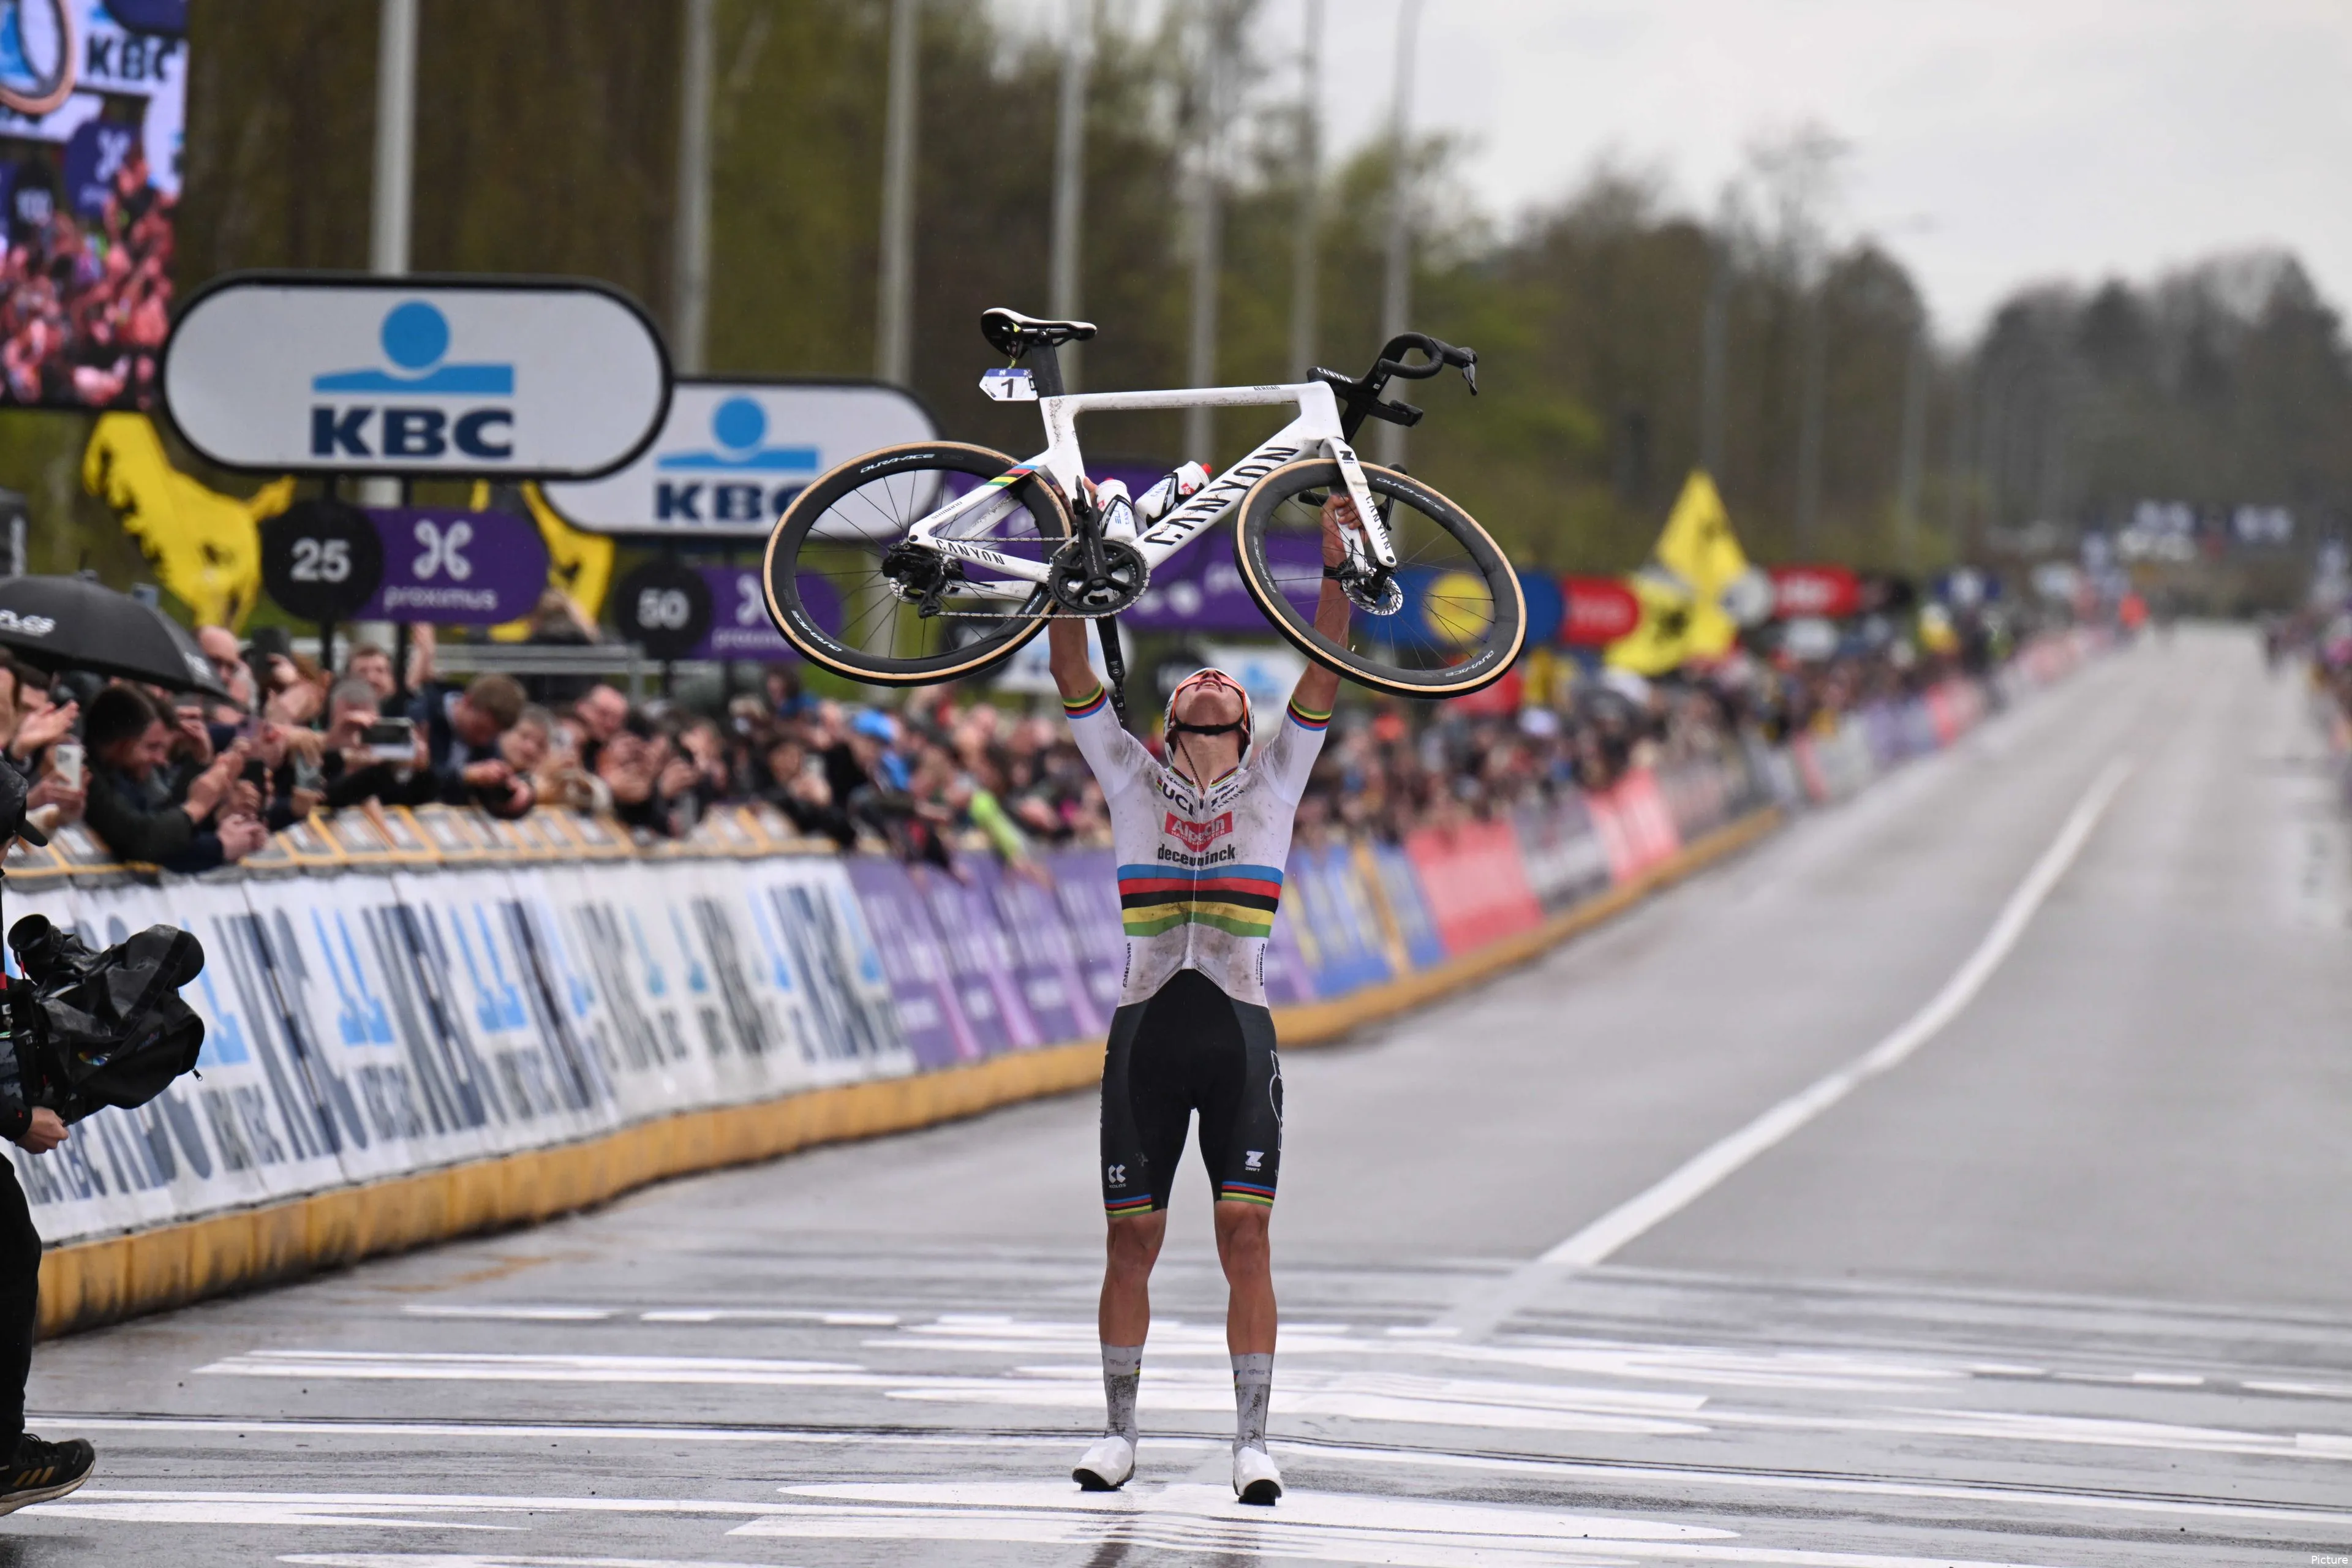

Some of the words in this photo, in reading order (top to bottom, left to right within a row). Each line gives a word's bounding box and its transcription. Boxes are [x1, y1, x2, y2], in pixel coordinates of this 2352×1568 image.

[1001, 378, 1014, 398] 1
[1317, 367, 1353, 383] CANYON
[311, 407, 514, 458] KBC
[859, 453, 936, 473] DURA-ACE
[1143, 447, 1300, 546] CANYON
[1376, 477, 1446, 512] DURA-ACE
[931, 501, 963, 520] SHIMANO
[1365, 495, 1392, 550] CANYON
[291, 537, 352, 582] 25
[935, 539, 1006, 565] CANYON
[1253, 535, 1277, 594] DURA-ACE
[383, 586, 498, 613] proximus
[791, 610, 843, 652] DURA-ACE
[1445, 649, 1495, 677] DURA-ACE
[1162, 782, 1195, 817] UCI
[1172, 818, 1225, 843] Alpecin
[1157, 843, 1236, 867] deceuninck
